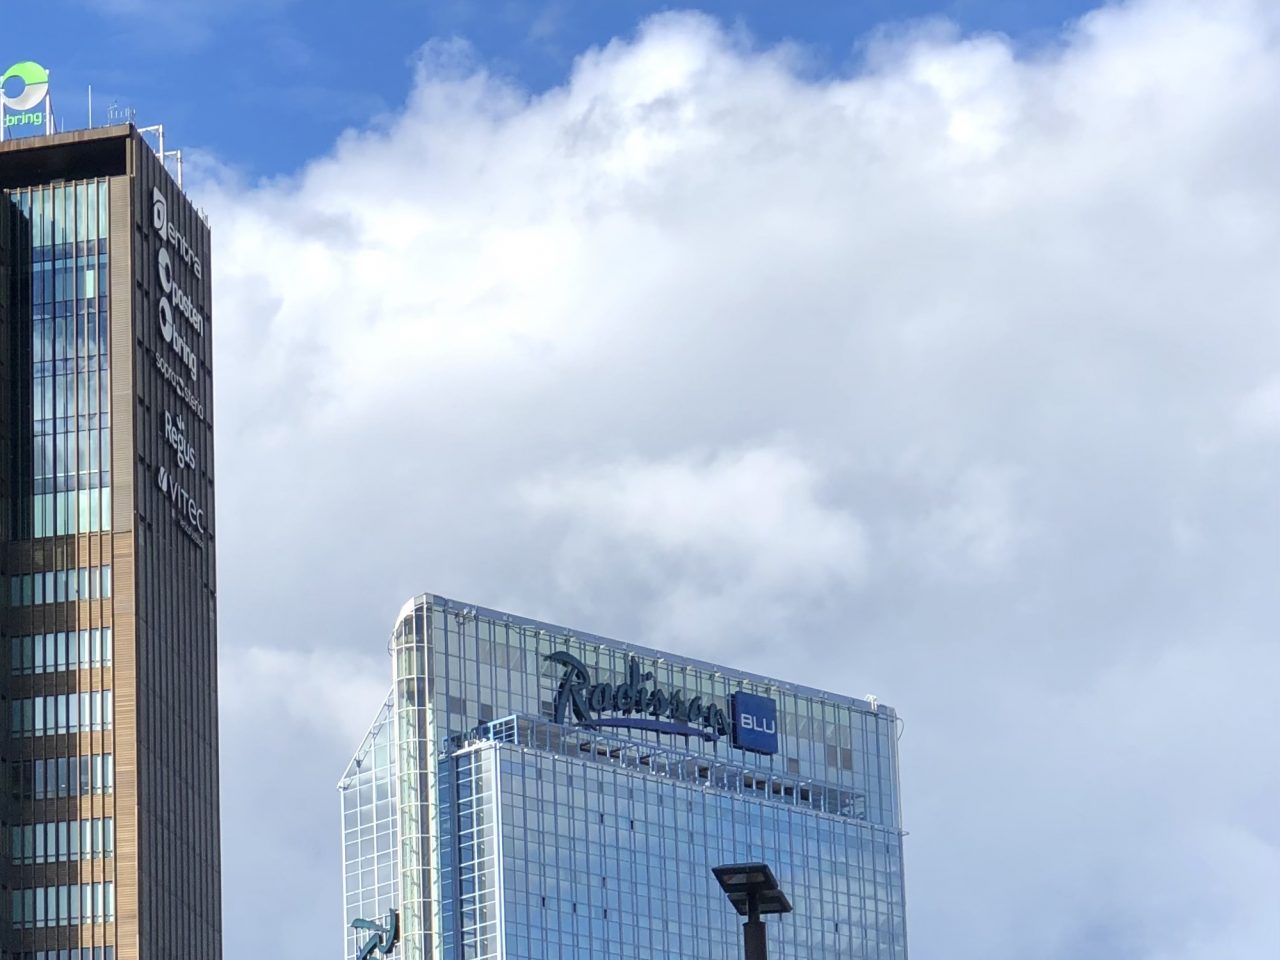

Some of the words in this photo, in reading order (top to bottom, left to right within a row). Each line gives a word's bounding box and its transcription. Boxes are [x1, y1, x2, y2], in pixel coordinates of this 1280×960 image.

[5, 112, 42, 127] bring
[168, 222, 202, 280] entra
[172, 281, 204, 337] posten
[173, 324, 197, 381] bring
[165, 410, 196, 469] Regus
[543, 650, 734, 738] Radisson
[740, 713, 775, 734] BLU
